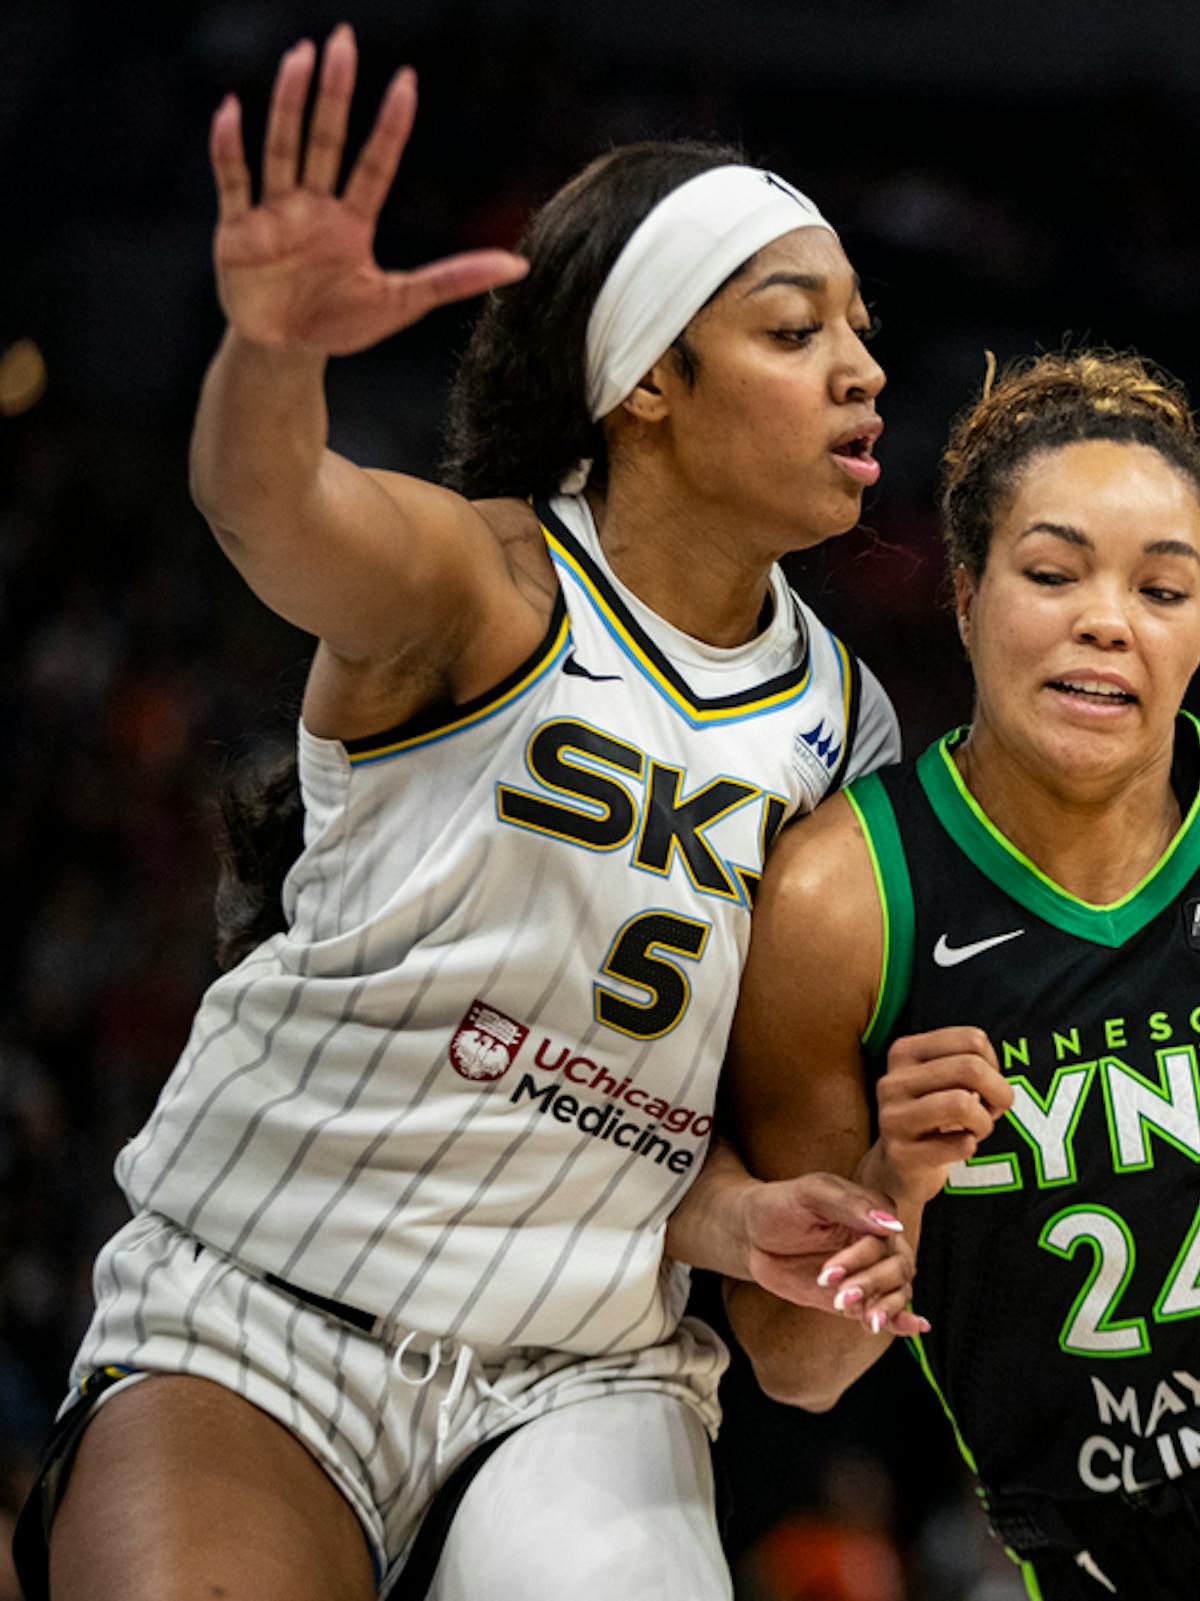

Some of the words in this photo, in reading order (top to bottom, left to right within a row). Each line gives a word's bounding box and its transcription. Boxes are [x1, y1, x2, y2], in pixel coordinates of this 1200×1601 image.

[593, 908, 712, 1041] 5
[509, 1073, 694, 1174] Medicine
[533, 1037, 714, 1138] UChicago
